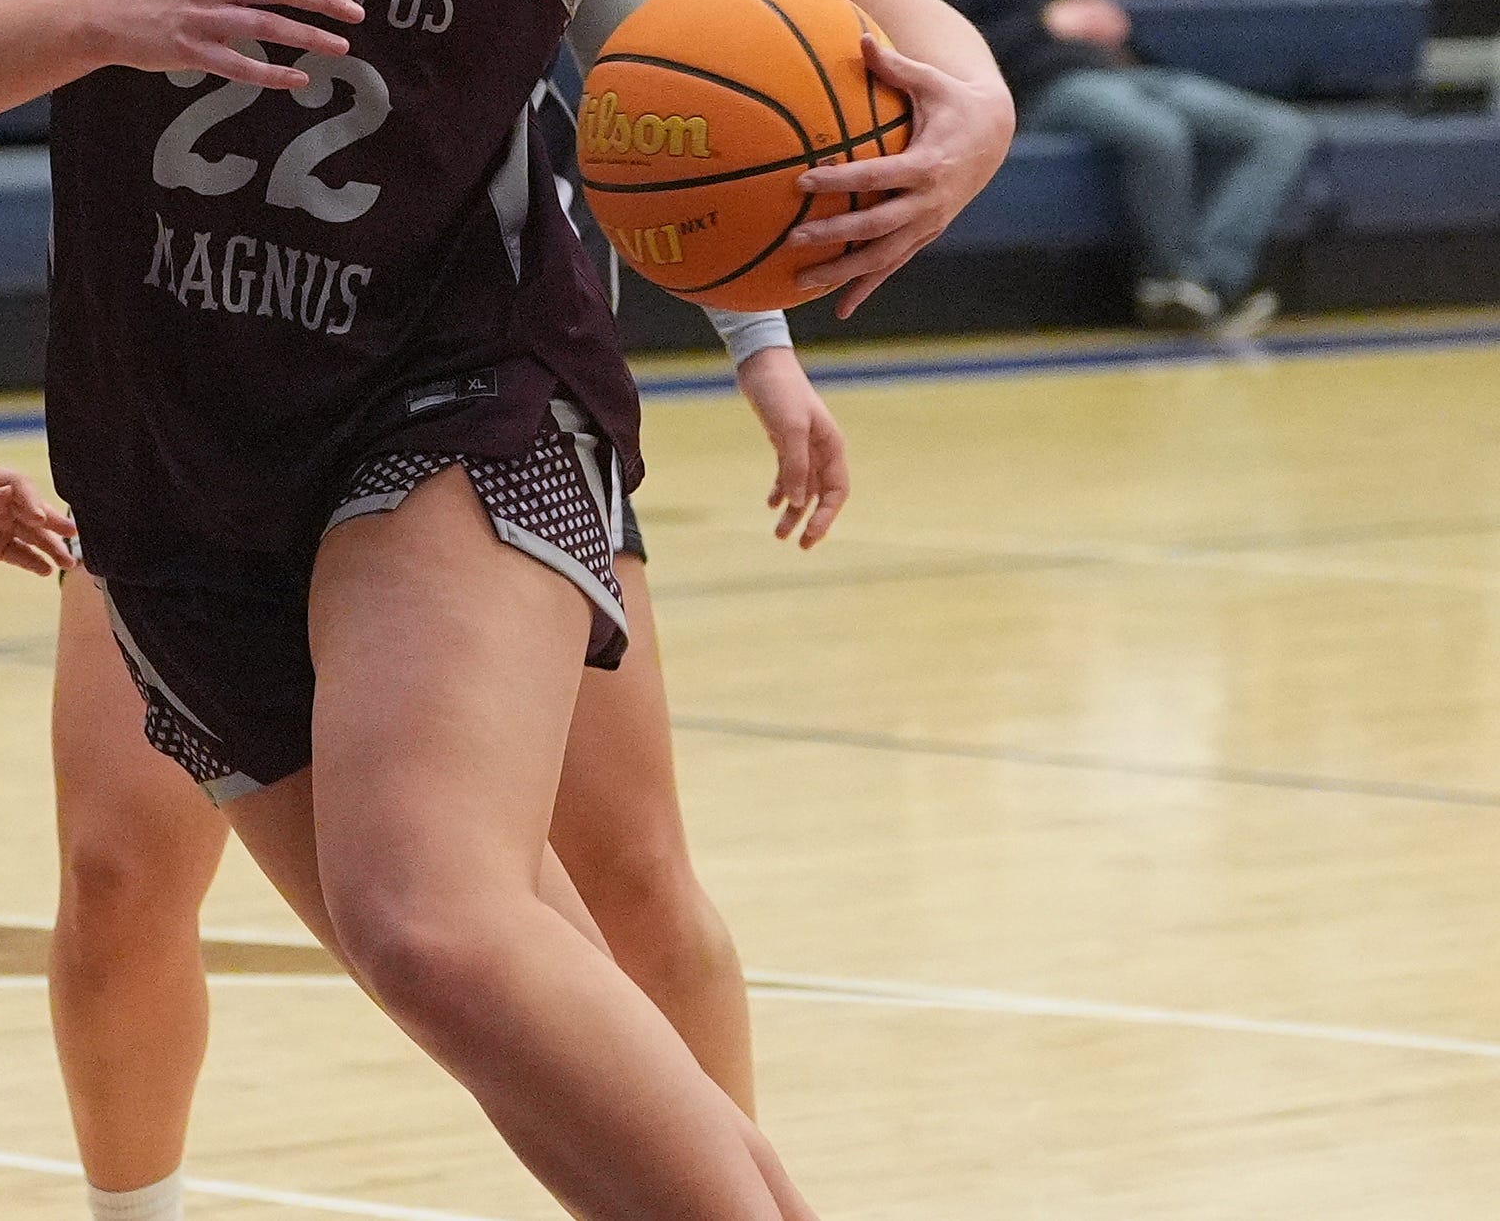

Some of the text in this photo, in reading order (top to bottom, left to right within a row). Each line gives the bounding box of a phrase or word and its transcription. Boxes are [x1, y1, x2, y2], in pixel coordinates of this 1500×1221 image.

[152, 39, 392, 222] 22
[580, 91, 713, 158] ilson
[468, 378, 488, 391] XL
